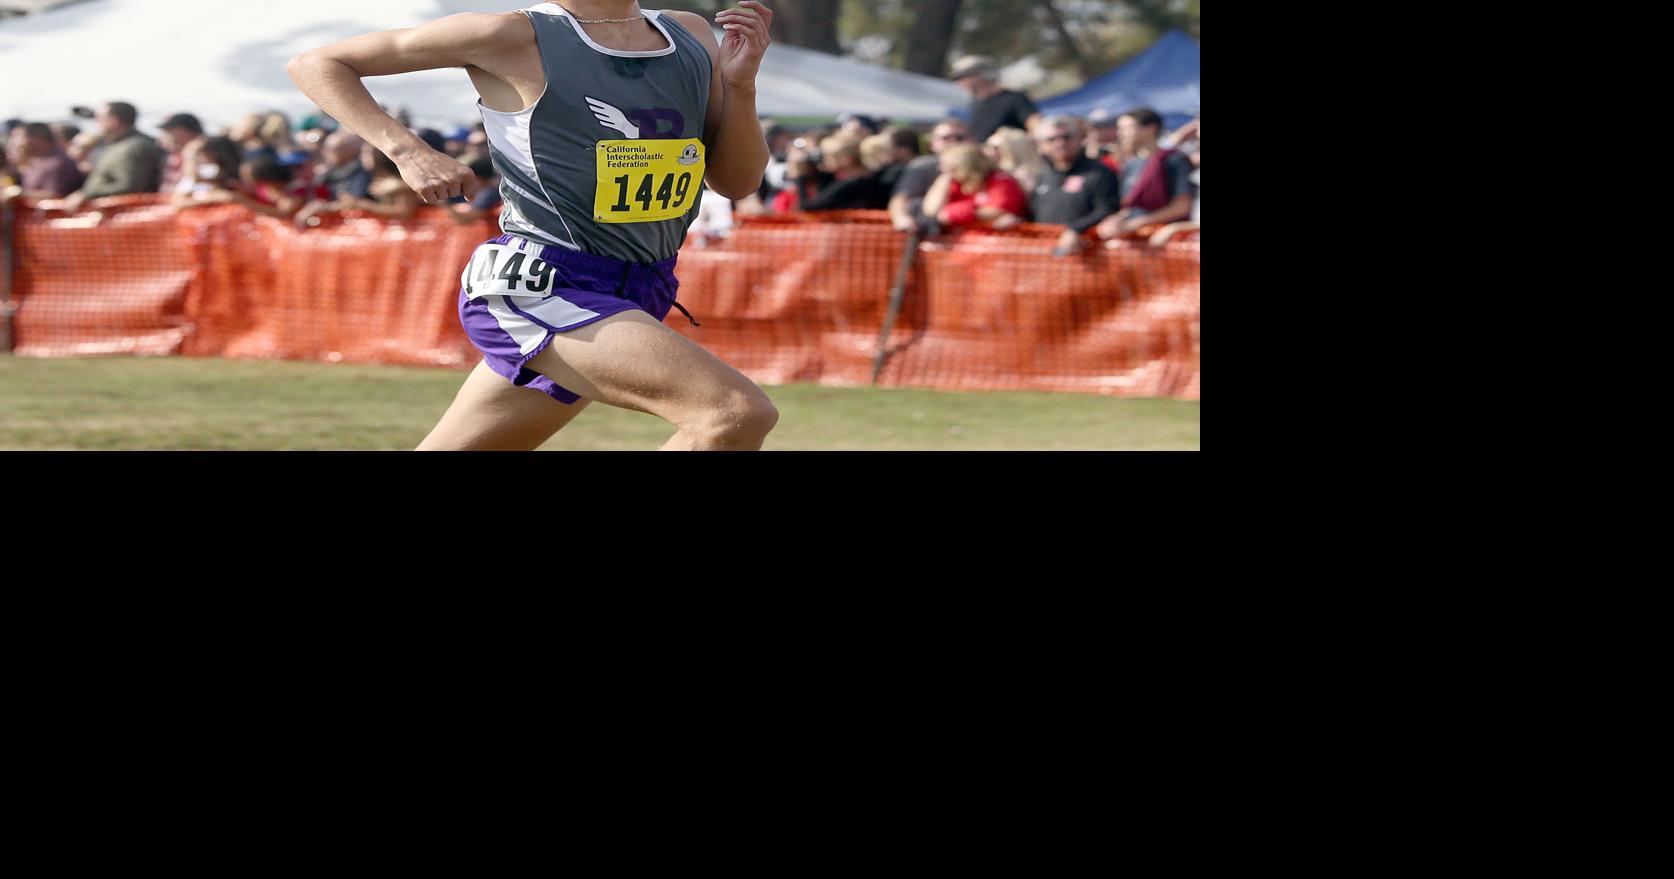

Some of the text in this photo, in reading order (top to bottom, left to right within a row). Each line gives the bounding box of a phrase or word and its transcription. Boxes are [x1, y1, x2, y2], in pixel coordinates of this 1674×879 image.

[606, 145, 646, 153] California
[607, 160, 649, 168] Federation
[611, 172, 691, 212] 1449
